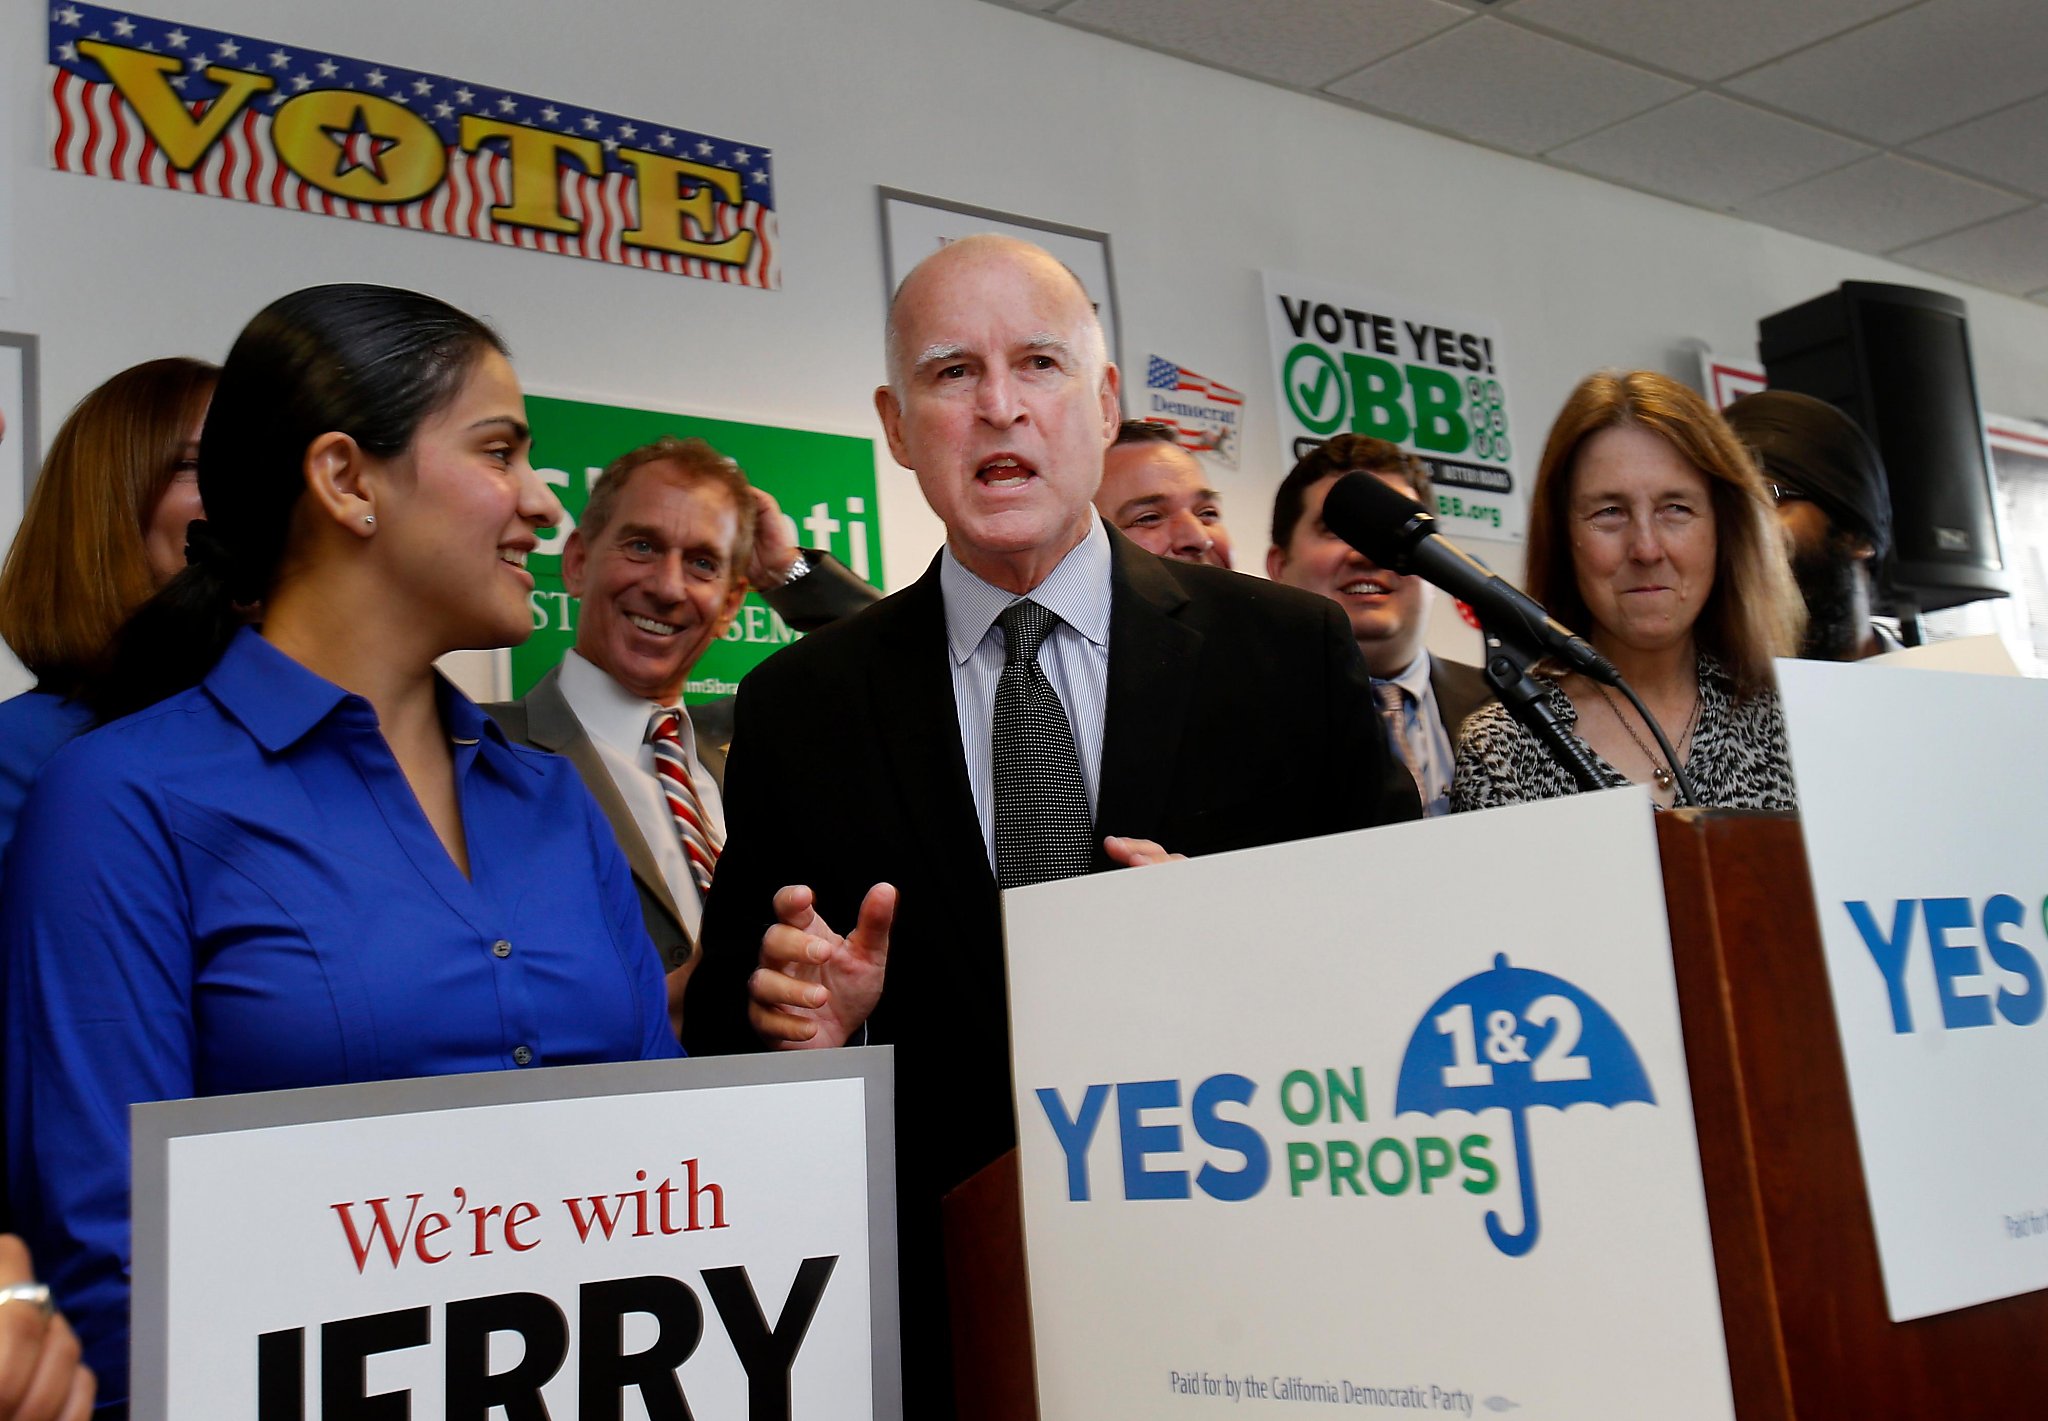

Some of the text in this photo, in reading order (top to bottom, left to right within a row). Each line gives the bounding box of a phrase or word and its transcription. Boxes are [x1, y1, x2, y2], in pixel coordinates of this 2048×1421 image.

[75, 37, 755, 267] VOTE
[1279, 293, 1495, 374] VOTE YES!
[1152, 393, 1235, 424] Democrat
[1342, 351, 1471, 454] BB
[1843, 893, 2046, 1035] YES
[1435, 994, 1592, 1088] 1&2
[1035, 1066, 1368, 1202] YES ON
[1287, 1134, 1500, 1197] PROPS
[329, 1157, 729, 1275] We're with
[1171, 1371, 1474, 1419] Paid for by the California Democratic Party
